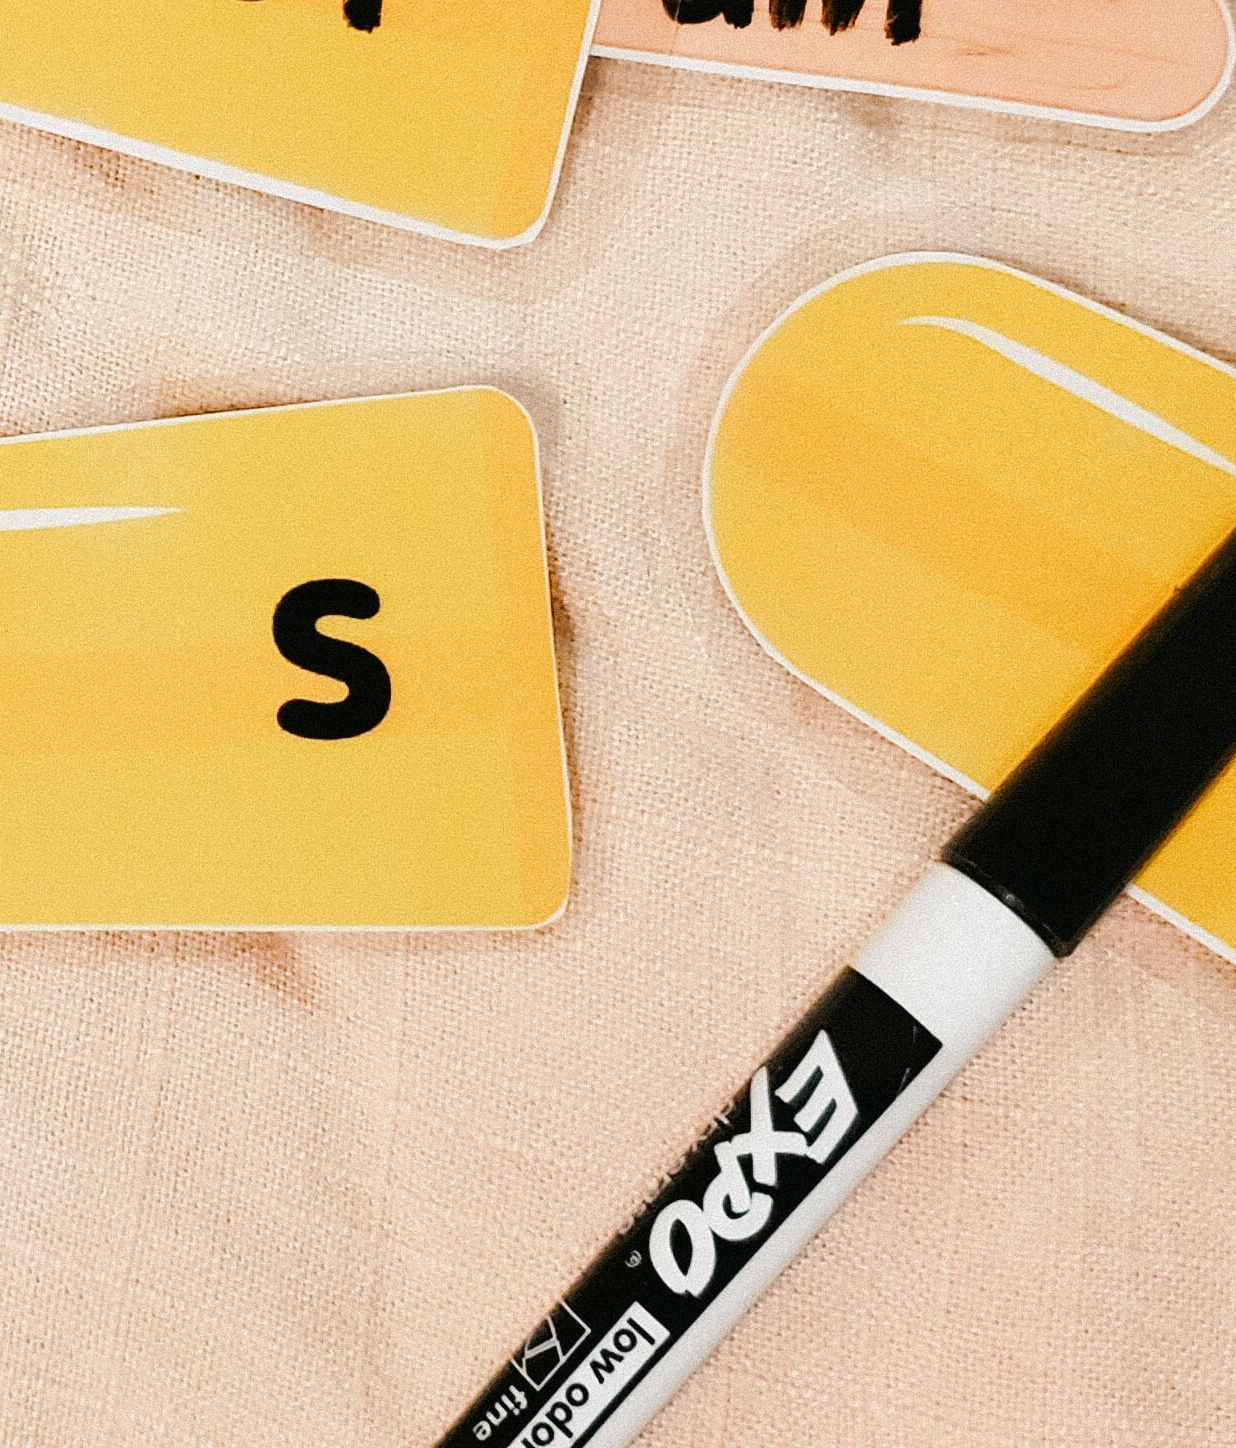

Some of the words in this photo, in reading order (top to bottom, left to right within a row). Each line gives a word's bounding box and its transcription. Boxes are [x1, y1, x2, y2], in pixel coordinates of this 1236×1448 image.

[272, 578, 392, 741] s
[649, 1029, 858, 1298] EXPO
[589, 1317, 656, 1384] low
[472, 1384, 529, 1441] fine
